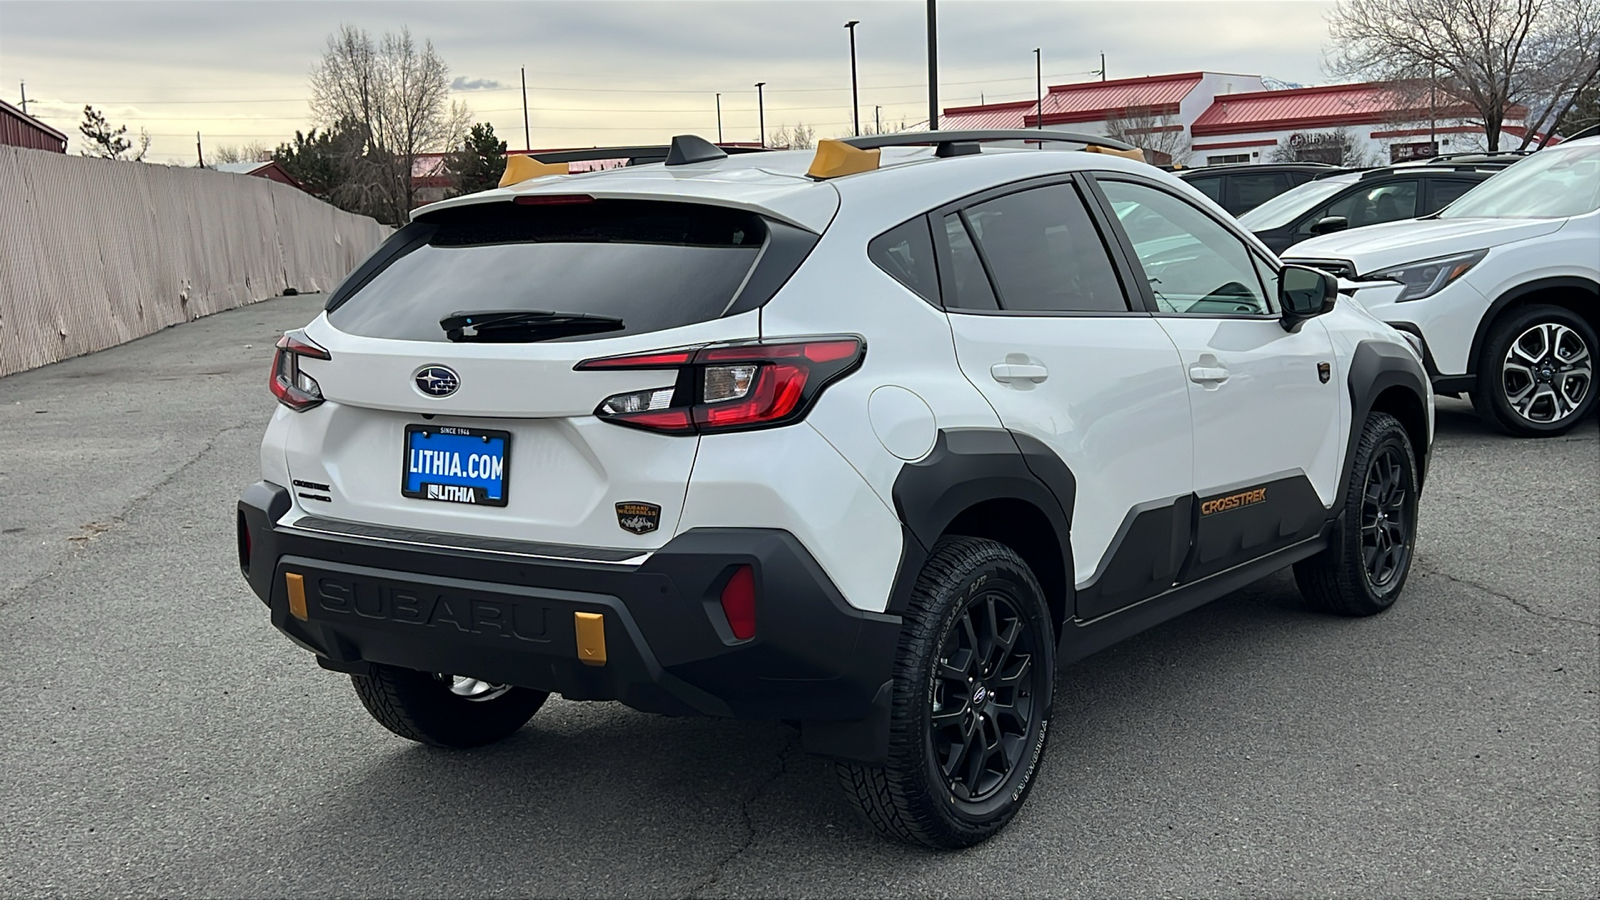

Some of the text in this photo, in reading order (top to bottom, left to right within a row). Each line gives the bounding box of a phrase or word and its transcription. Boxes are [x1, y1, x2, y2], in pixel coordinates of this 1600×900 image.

[440, 427, 470, 436] SINCE 1946
[409, 448, 504, 481] LITHIA.COM
[438, 484, 476, 503] LITHIA
[1201, 487, 1267, 515] CROSSTREK
[318, 578, 552, 643] SUBARU
